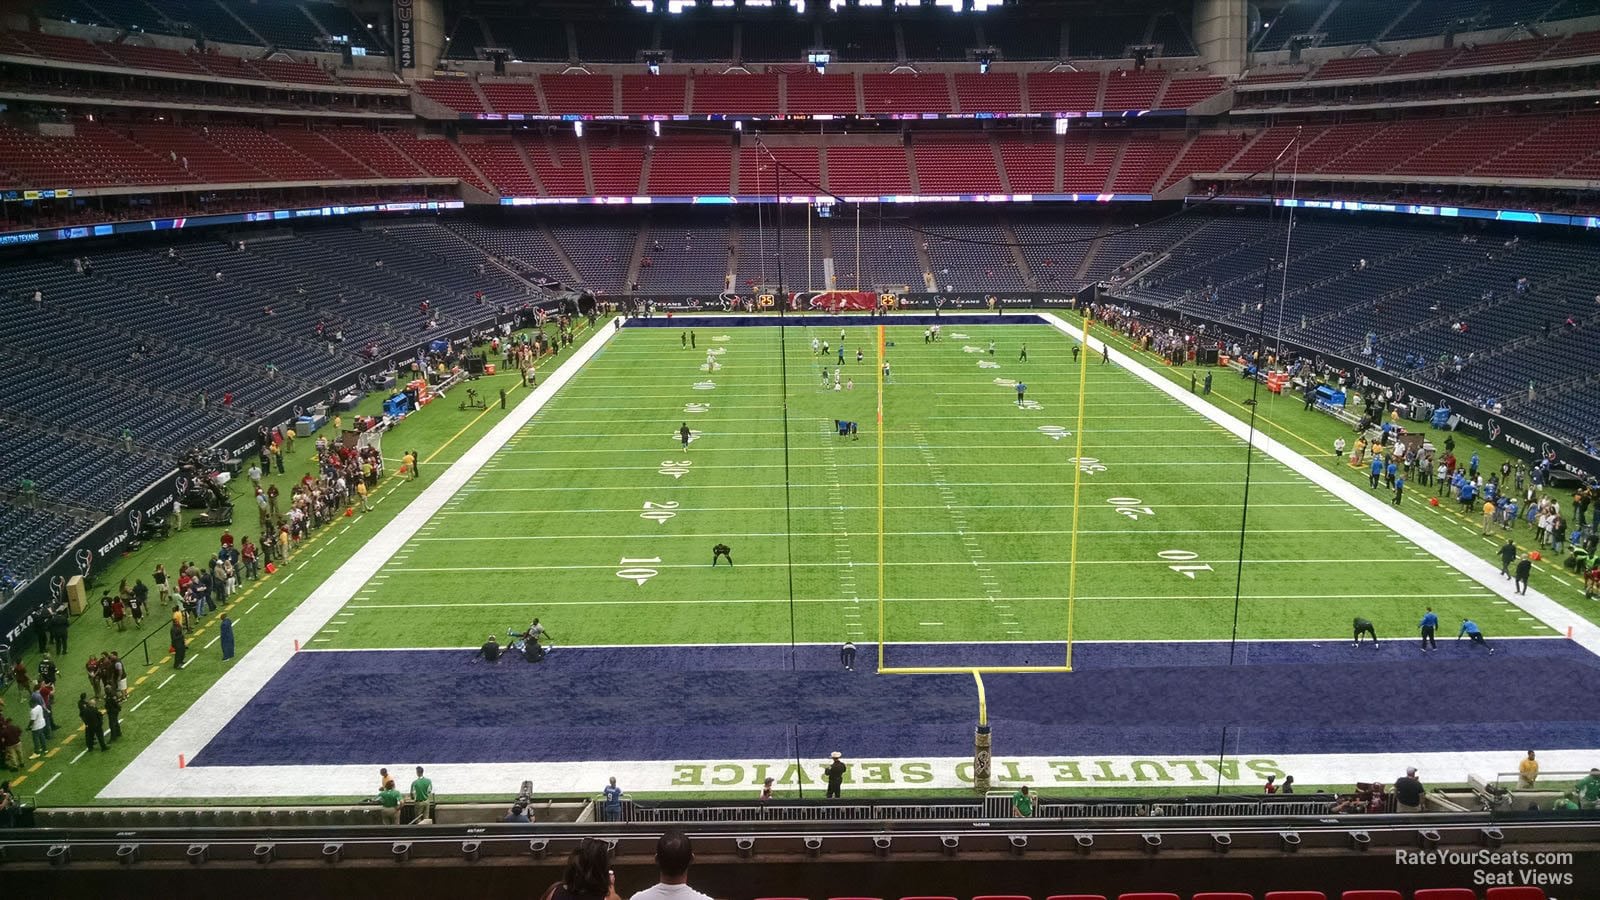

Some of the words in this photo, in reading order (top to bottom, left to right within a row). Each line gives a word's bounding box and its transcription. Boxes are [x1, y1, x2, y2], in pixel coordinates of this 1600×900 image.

[19, 233, 39, 242] TEXANS
[1456, 413, 1484, 431] TEXANS
[1505, 434, 1536, 454] TEXANS
[146, 494, 174, 518] TEXANS
[639, 501, 679, 519] 20
[1106, 497, 1155, 515] 20
[98, 530, 129, 557] TEXANS
[616, 556, 662, 579] 10
[1157, 550, 1215, 572] 10
[1049, 759, 1287, 782] SALUTE
